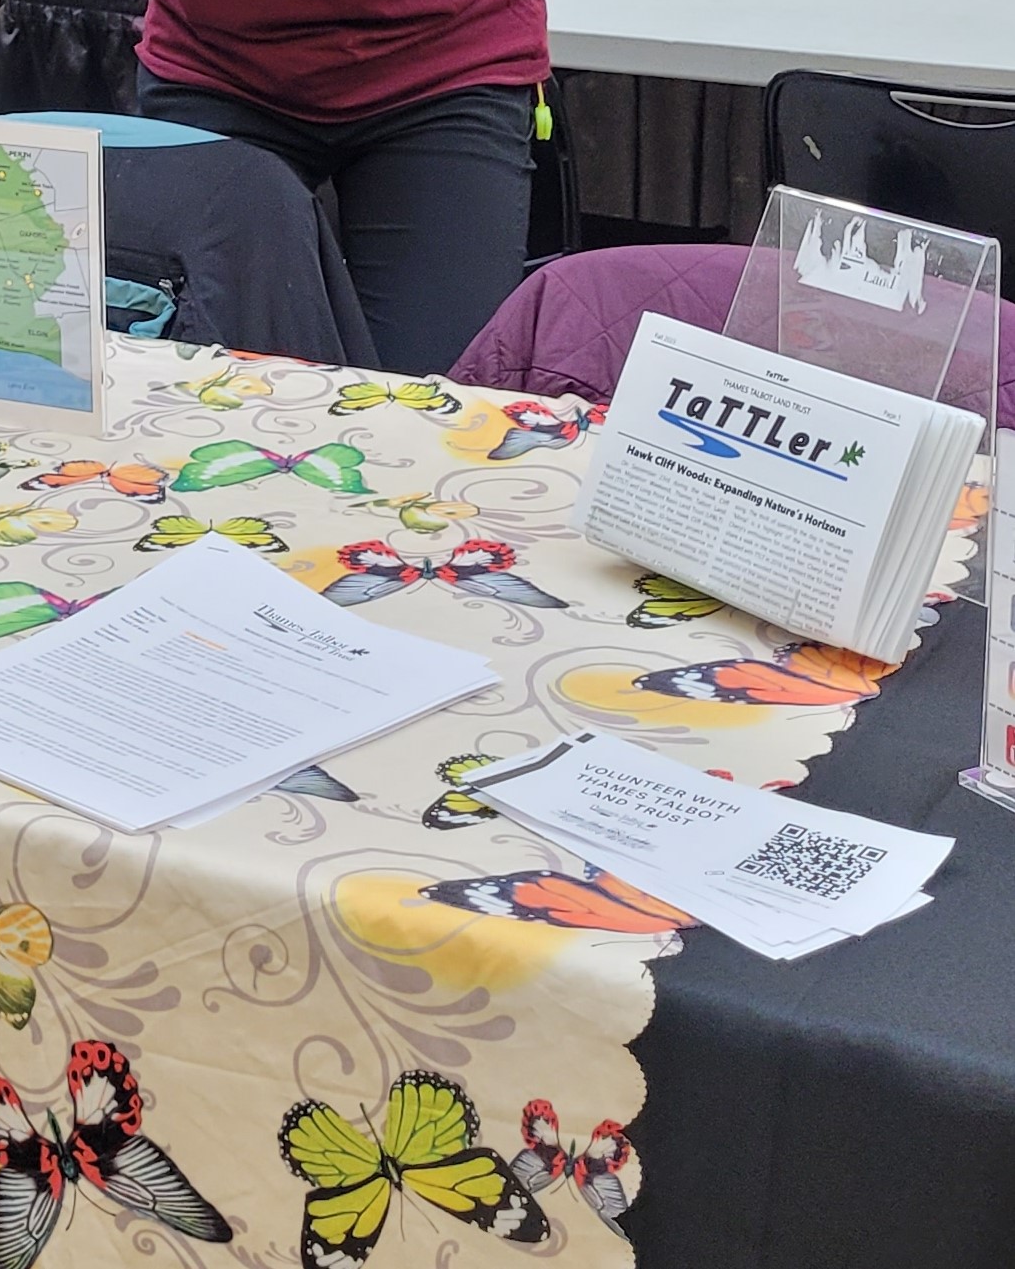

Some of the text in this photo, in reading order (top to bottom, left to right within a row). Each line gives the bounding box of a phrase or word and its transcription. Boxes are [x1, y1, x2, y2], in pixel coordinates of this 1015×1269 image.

[664, 377, 833, 463] TaTTLer
[723, 378, 812, 415] THAMES TALBOT LAND TRUST
[626, 444, 847, 538] Hawk Cliff Woods: Expanding Nature's Horizons
[257, 604, 304, 632] Thames
[576, 773, 649, 800] THAMES
[656, 797, 727, 822] TALBOT
[580, 787, 628, 806] LAND
[635, 804, 695, 826] TRUST
[584, 763, 742, 814] VOLUNTEER WITH
